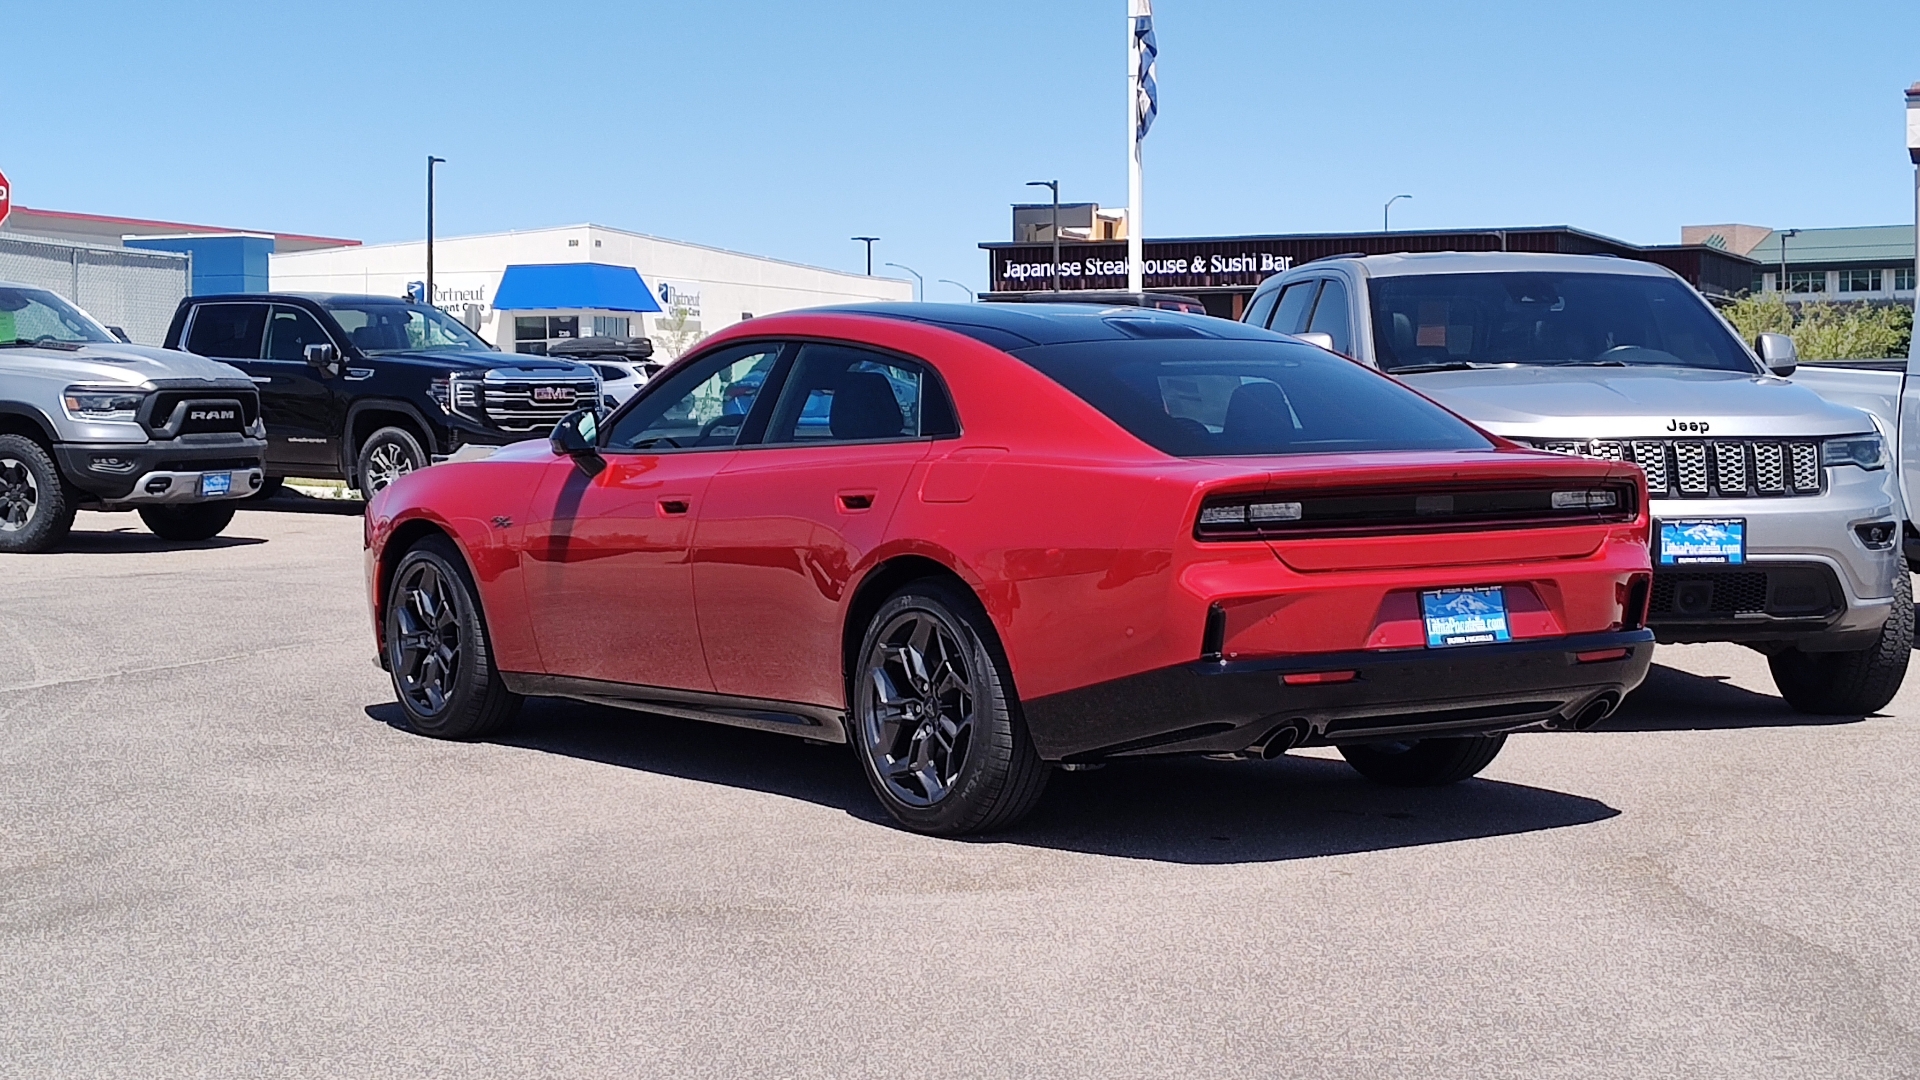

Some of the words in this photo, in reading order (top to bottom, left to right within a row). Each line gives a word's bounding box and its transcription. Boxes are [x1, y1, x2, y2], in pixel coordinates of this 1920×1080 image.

[1003, 260, 1082, 281] Japanese
[1190, 255, 1206, 274] &
[1210, 252, 1256, 273] Sushi
[1260, 252, 1293, 272] Bar
[534, 387, 576, 400] GMC
[190, 410, 235, 420] RAM
[1666, 418, 1710, 434] Jeep
